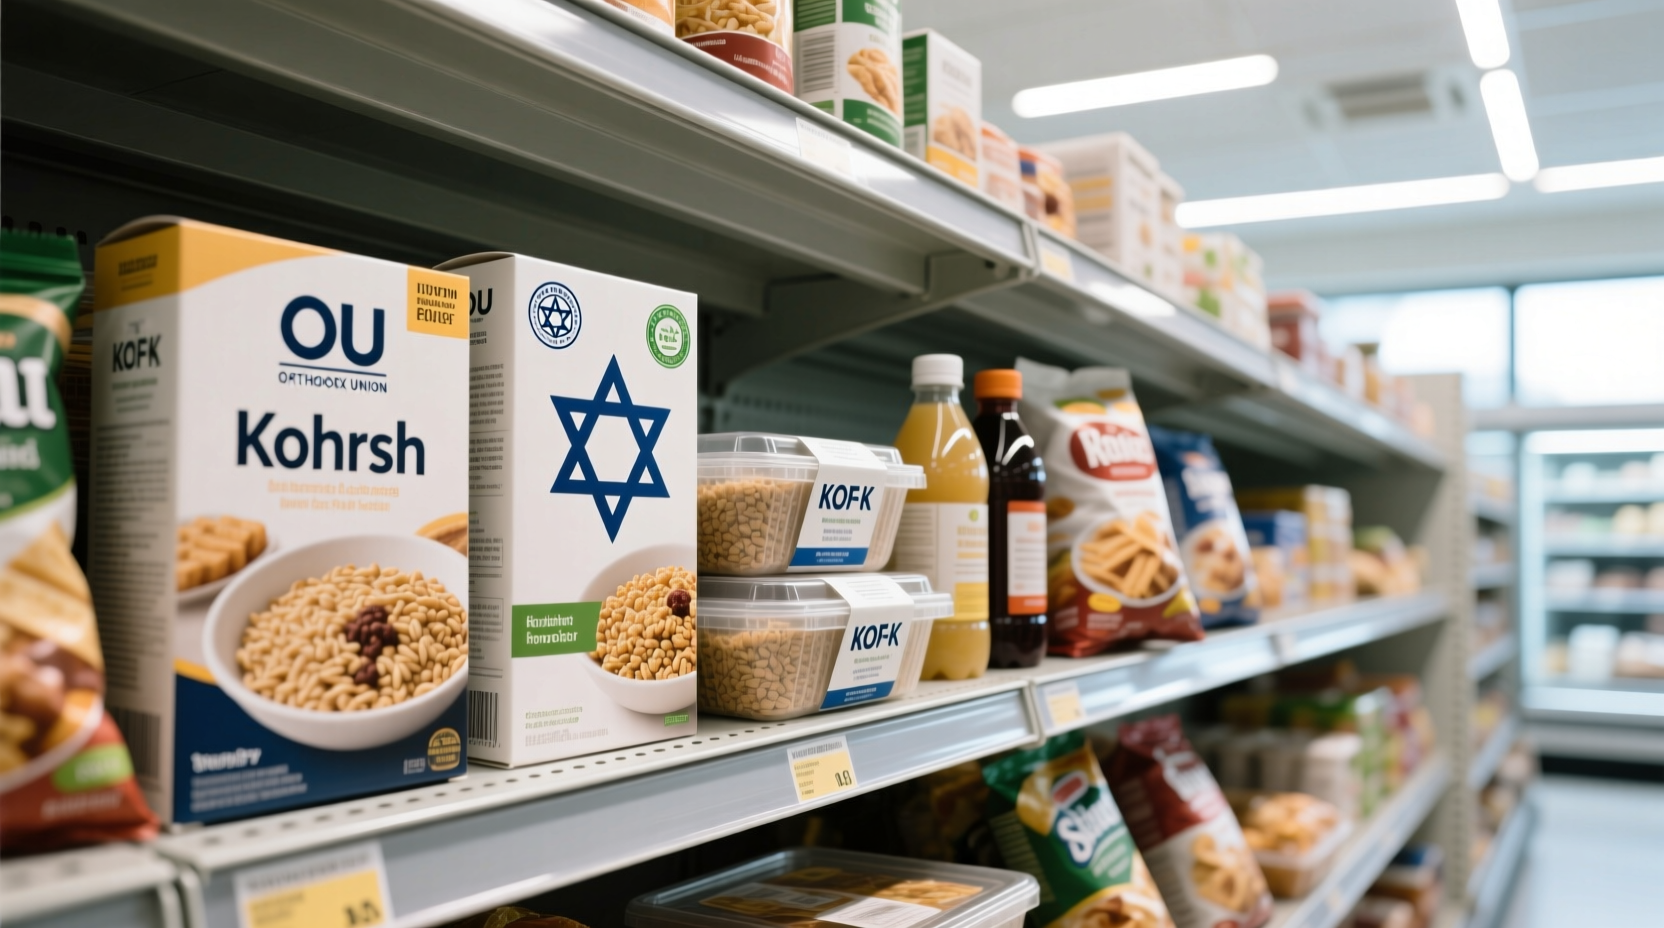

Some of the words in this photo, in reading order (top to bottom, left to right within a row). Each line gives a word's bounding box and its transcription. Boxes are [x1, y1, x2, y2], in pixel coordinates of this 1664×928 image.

[280, 295, 385, 366] OU
[350, 378, 388, 393] UNION
[236, 410, 425, 476] Kohrsh
